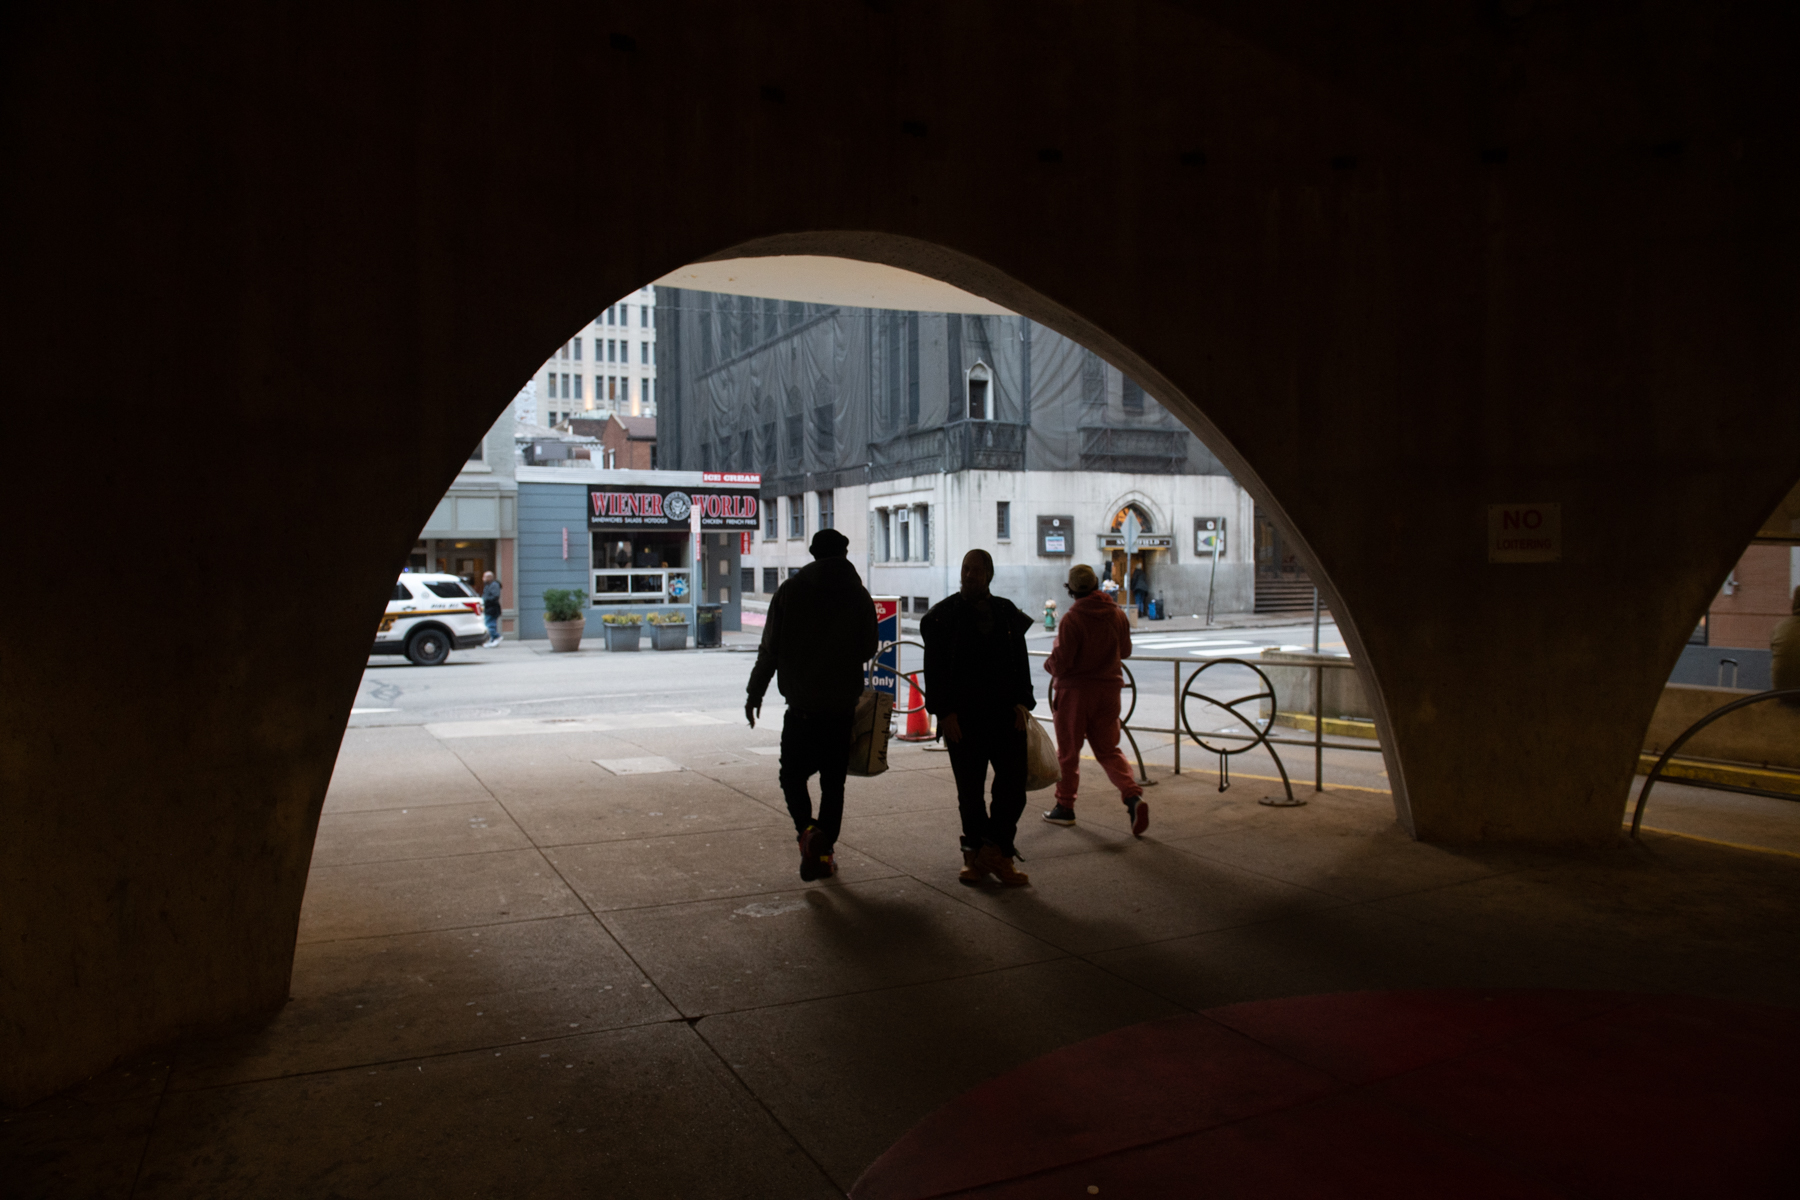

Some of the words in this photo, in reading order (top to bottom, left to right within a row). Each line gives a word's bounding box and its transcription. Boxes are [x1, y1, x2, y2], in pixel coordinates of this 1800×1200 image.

[703, 474, 721, 482] ICE
[723, 474, 760, 482] CREAM
[591, 492, 664, 516] WIENER
[692, 494, 757, 518] WORLD
[1503, 509, 1543, 530] NO
[1496, 538, 1552, 550] LOITERING
[872, 675, 895, 688] Only
